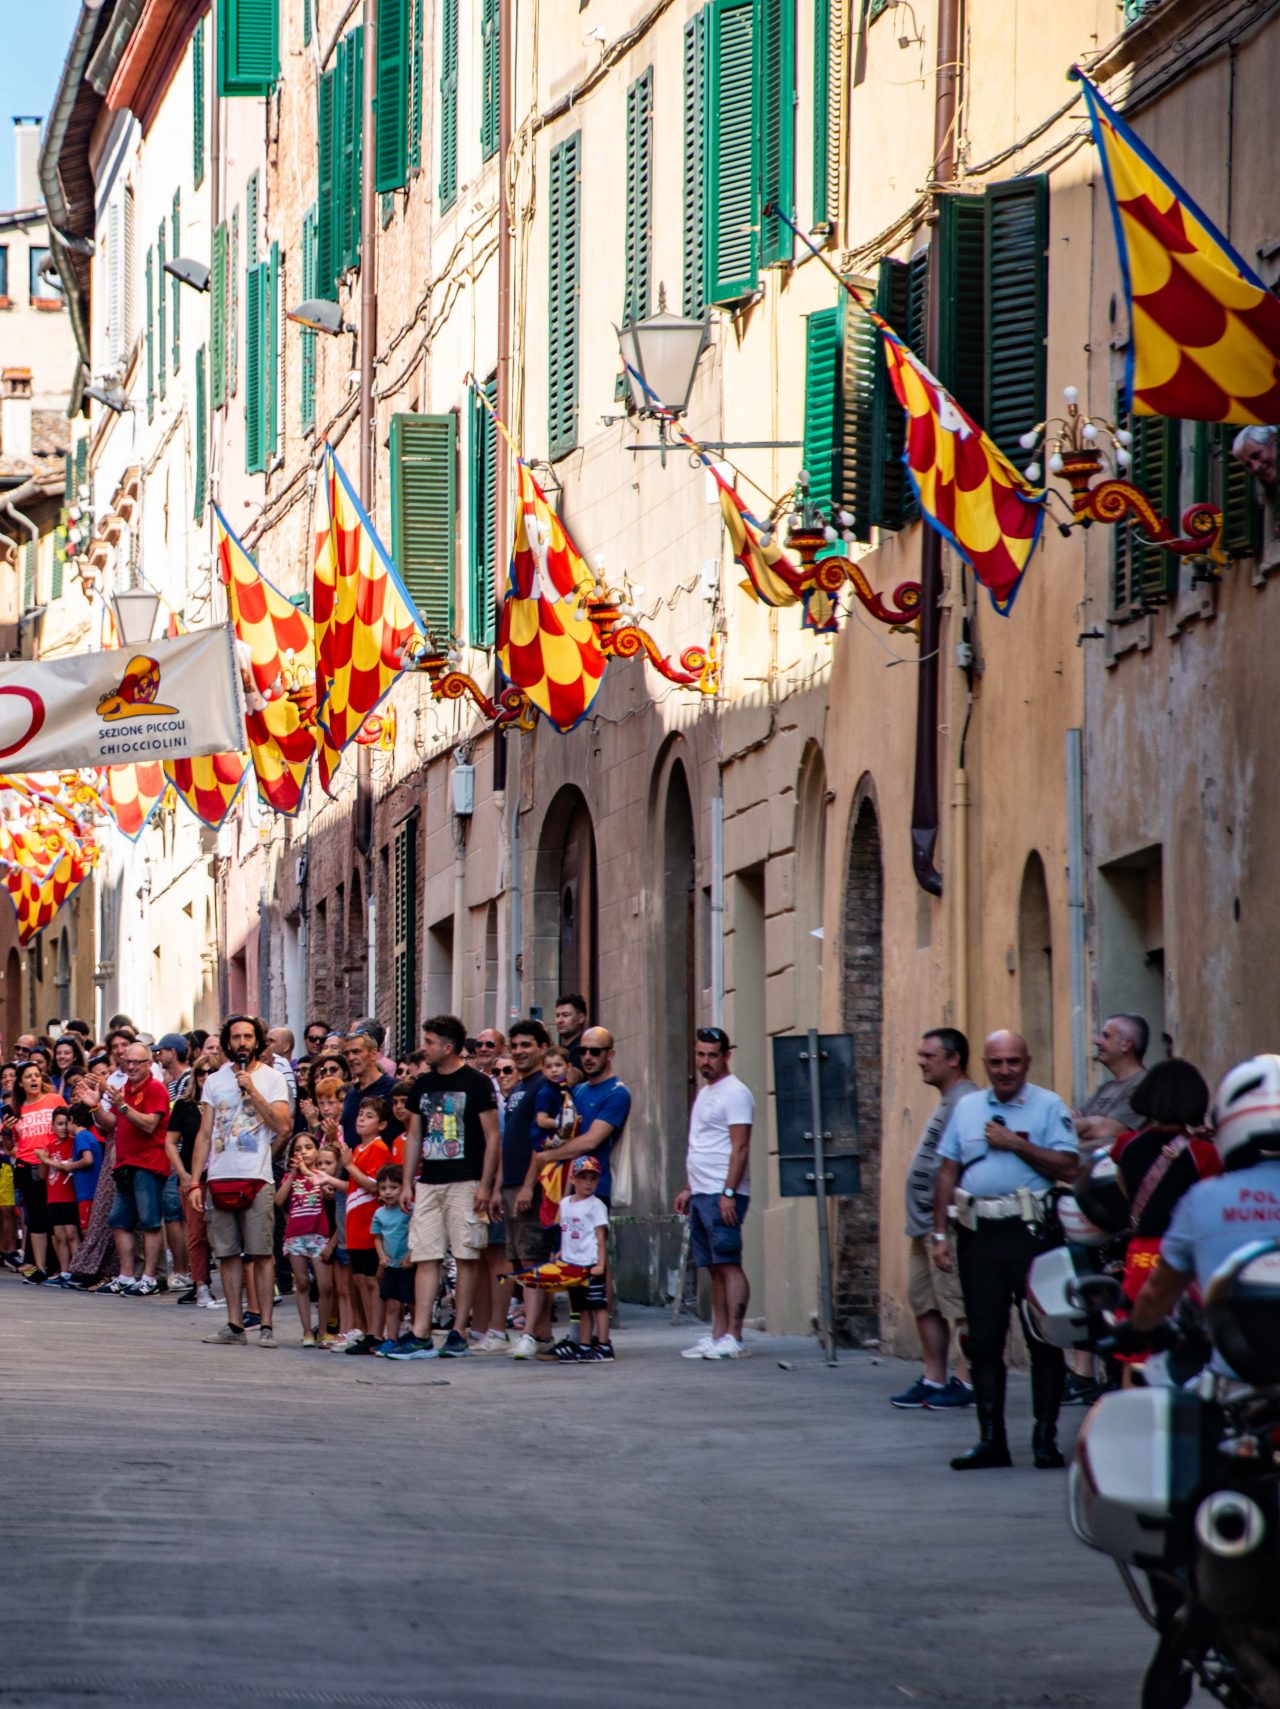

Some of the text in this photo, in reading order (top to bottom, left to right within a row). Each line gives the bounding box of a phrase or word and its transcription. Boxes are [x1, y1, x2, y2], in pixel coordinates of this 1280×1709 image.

[99, 720, 185, 739] SEZIONE PICCOLI
[100, 737, 187, 755] CHIOCCIOLINI
